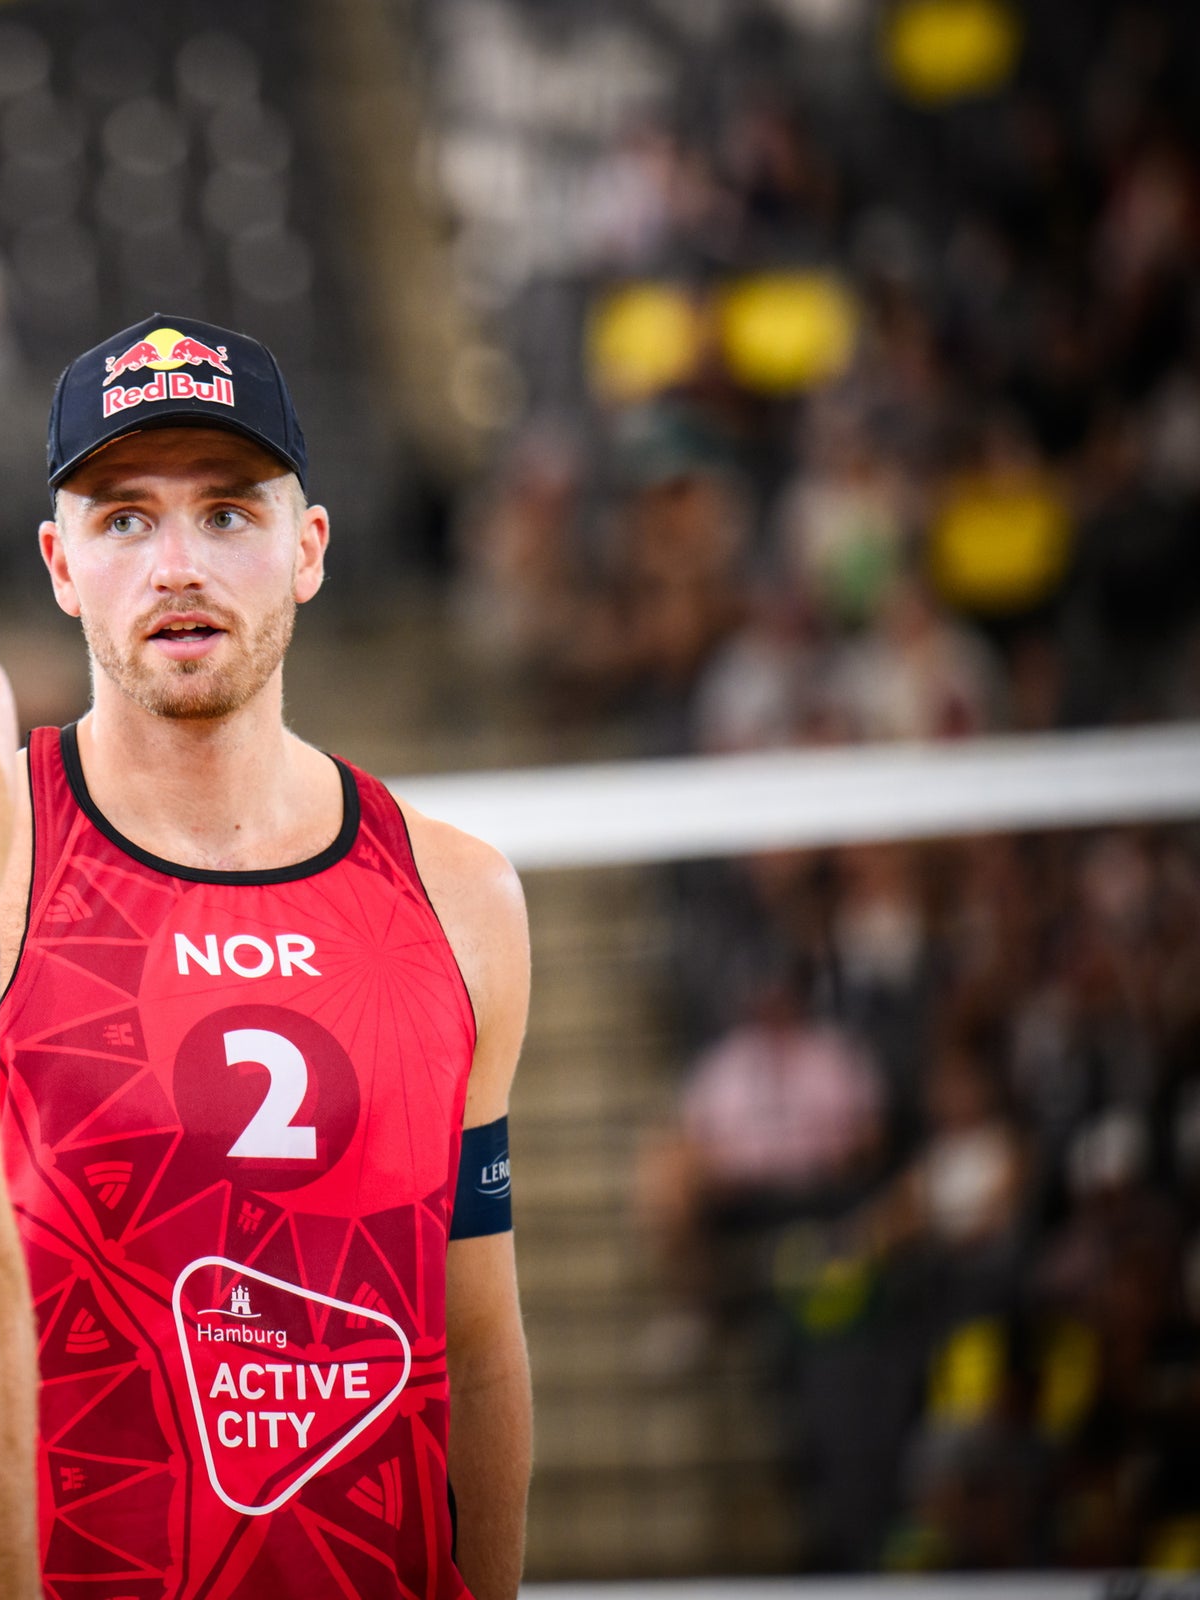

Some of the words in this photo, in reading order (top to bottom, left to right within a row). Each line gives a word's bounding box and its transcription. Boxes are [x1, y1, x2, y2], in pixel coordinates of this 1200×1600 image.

[103, 372, 166, 418] Red
[168, 372, 234, 406] Bull
[174, 933, 322, 978] NOR
[223, 1028, 317, 1159] 2
[197, 1324, 287, 1348] Hamburg
[209, 1363, 371, 1400] ACTIVE
[217, 1411, 316, 1448] CITY
